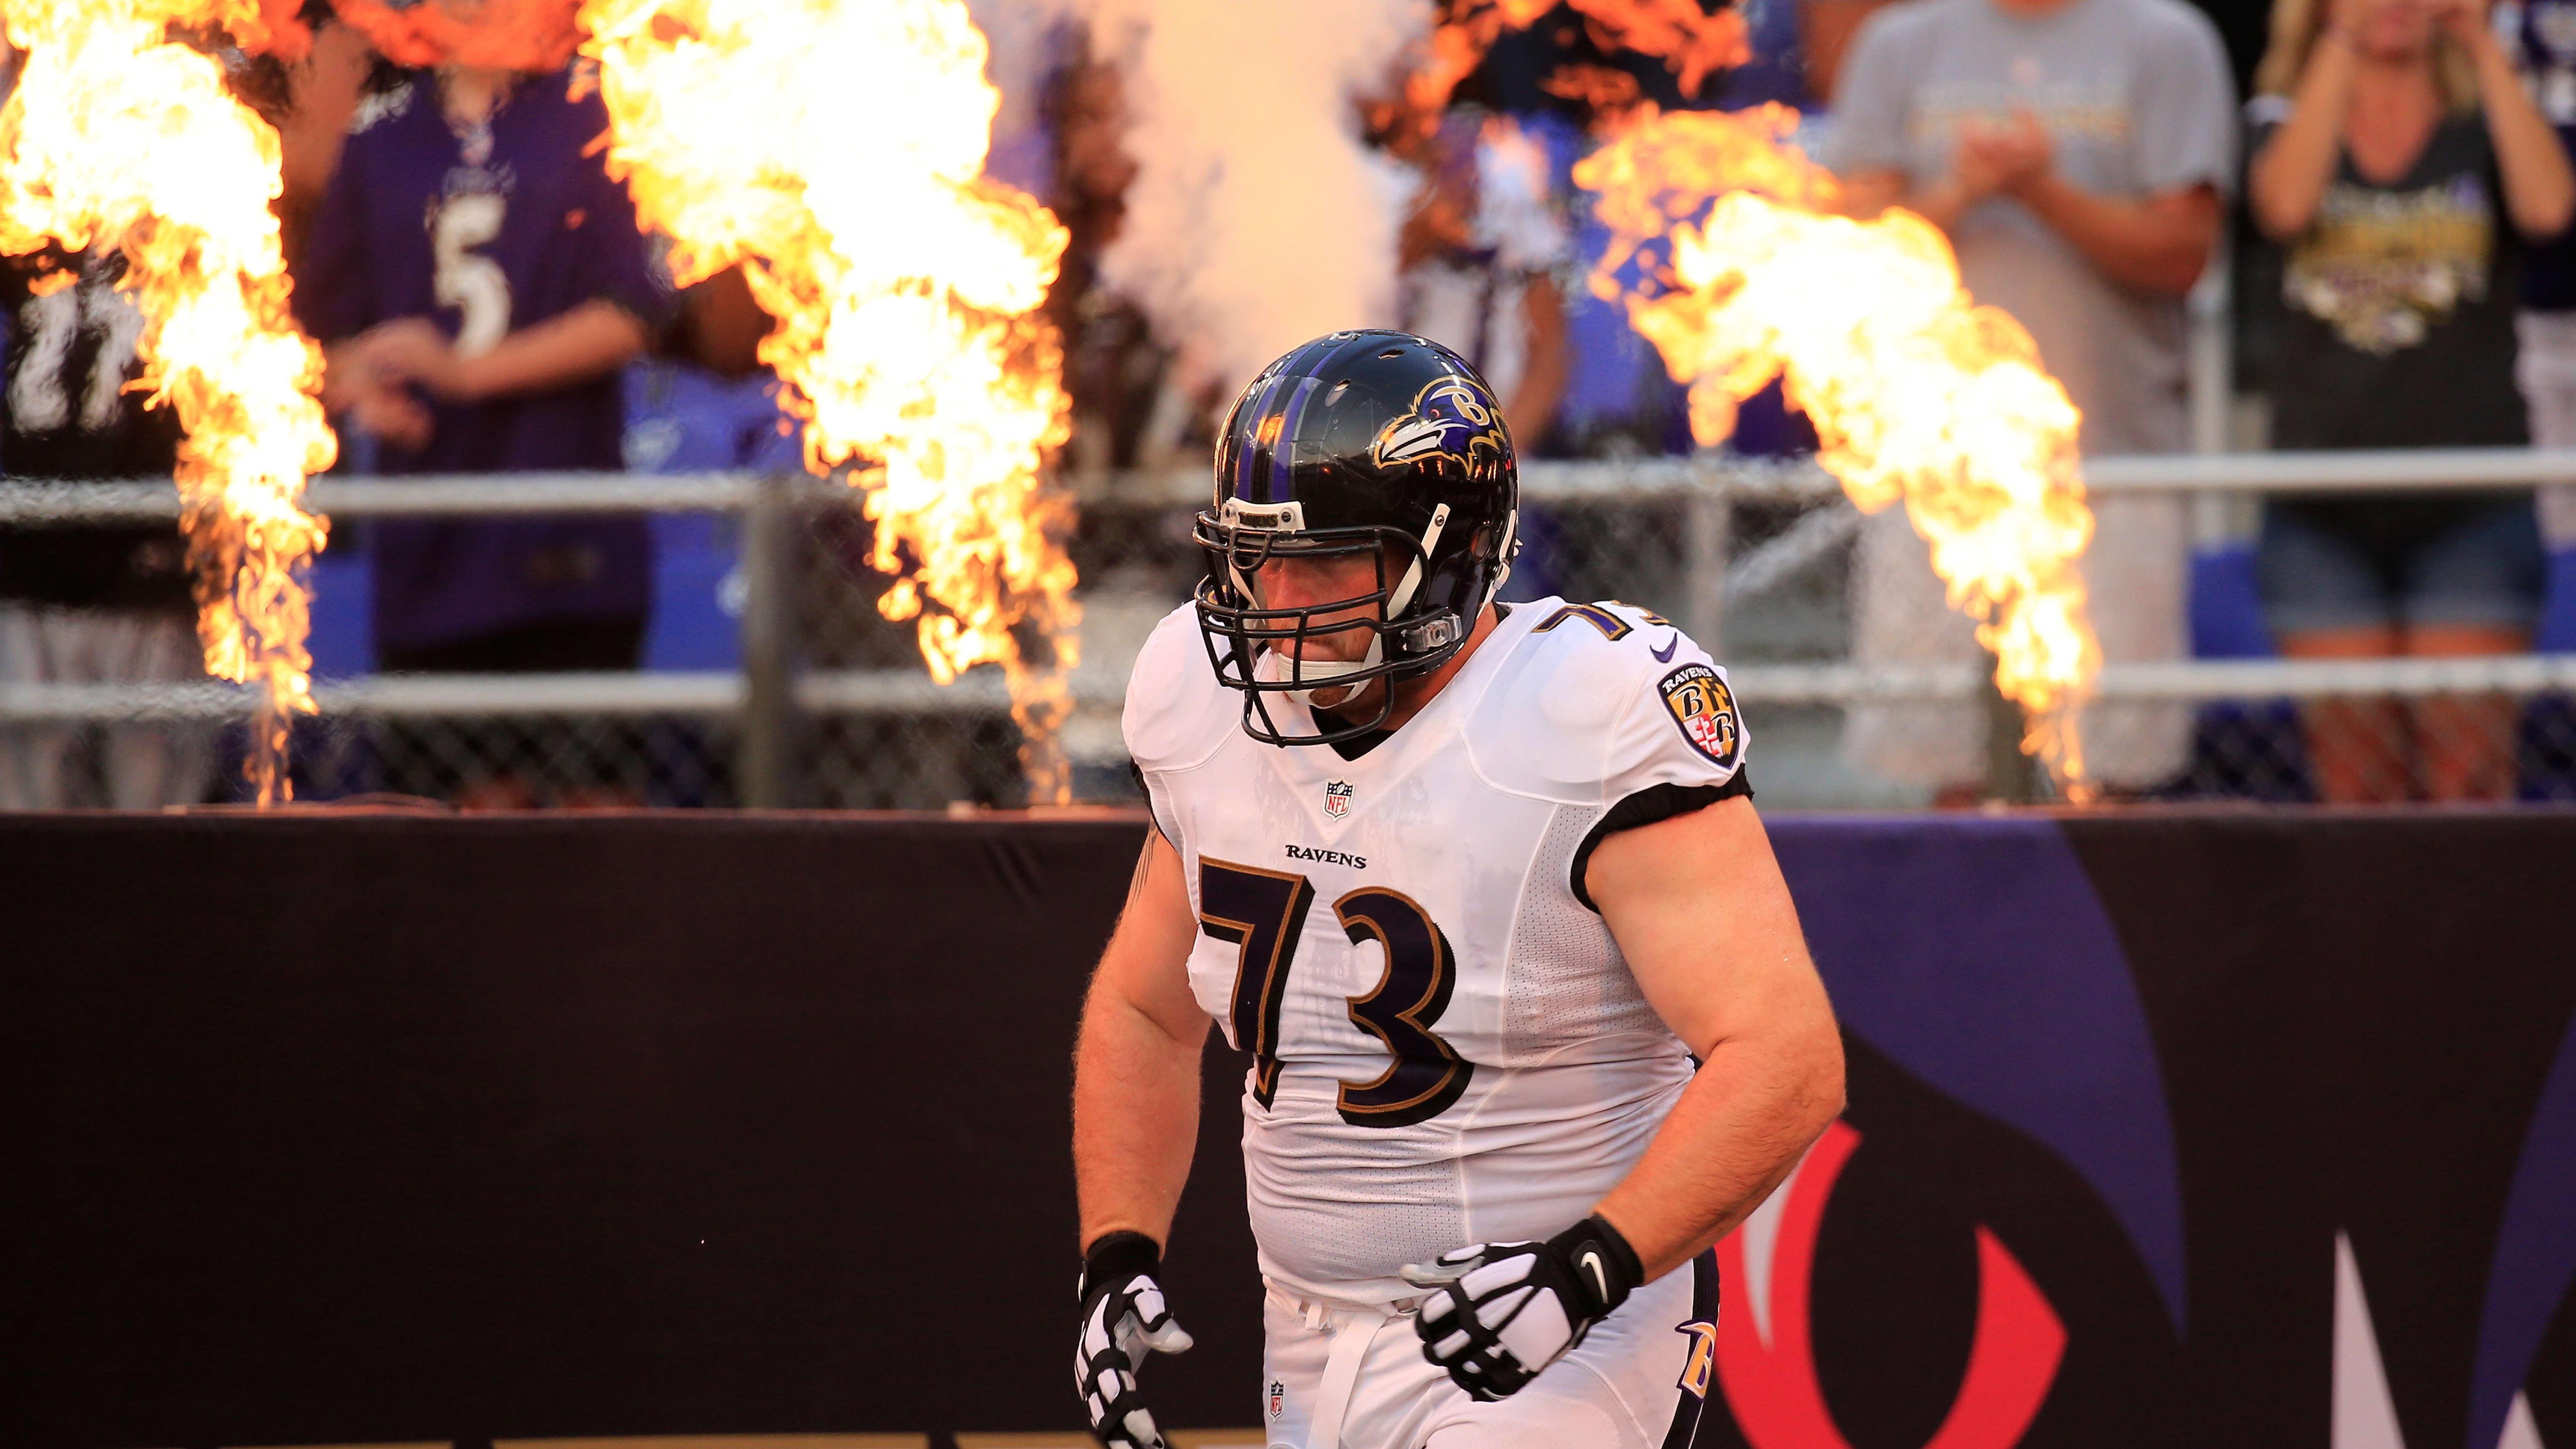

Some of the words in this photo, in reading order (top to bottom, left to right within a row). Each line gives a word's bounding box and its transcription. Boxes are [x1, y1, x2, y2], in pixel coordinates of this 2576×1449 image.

[433, 193, 512, 361] 5
[1429, 386, 1490, 426] B
[1662, 667, 1713, 693] RAVENS
[1671, 683, 1703, 720] B
[1710, 710, 1735, 743] R
[1327, 795, 1347, 813] NFL
[1285, 845, 1367, 869] RAVENS
[1199, 854, 1474, 1128] 73
[1678, 1320, 1717, 1400] B
